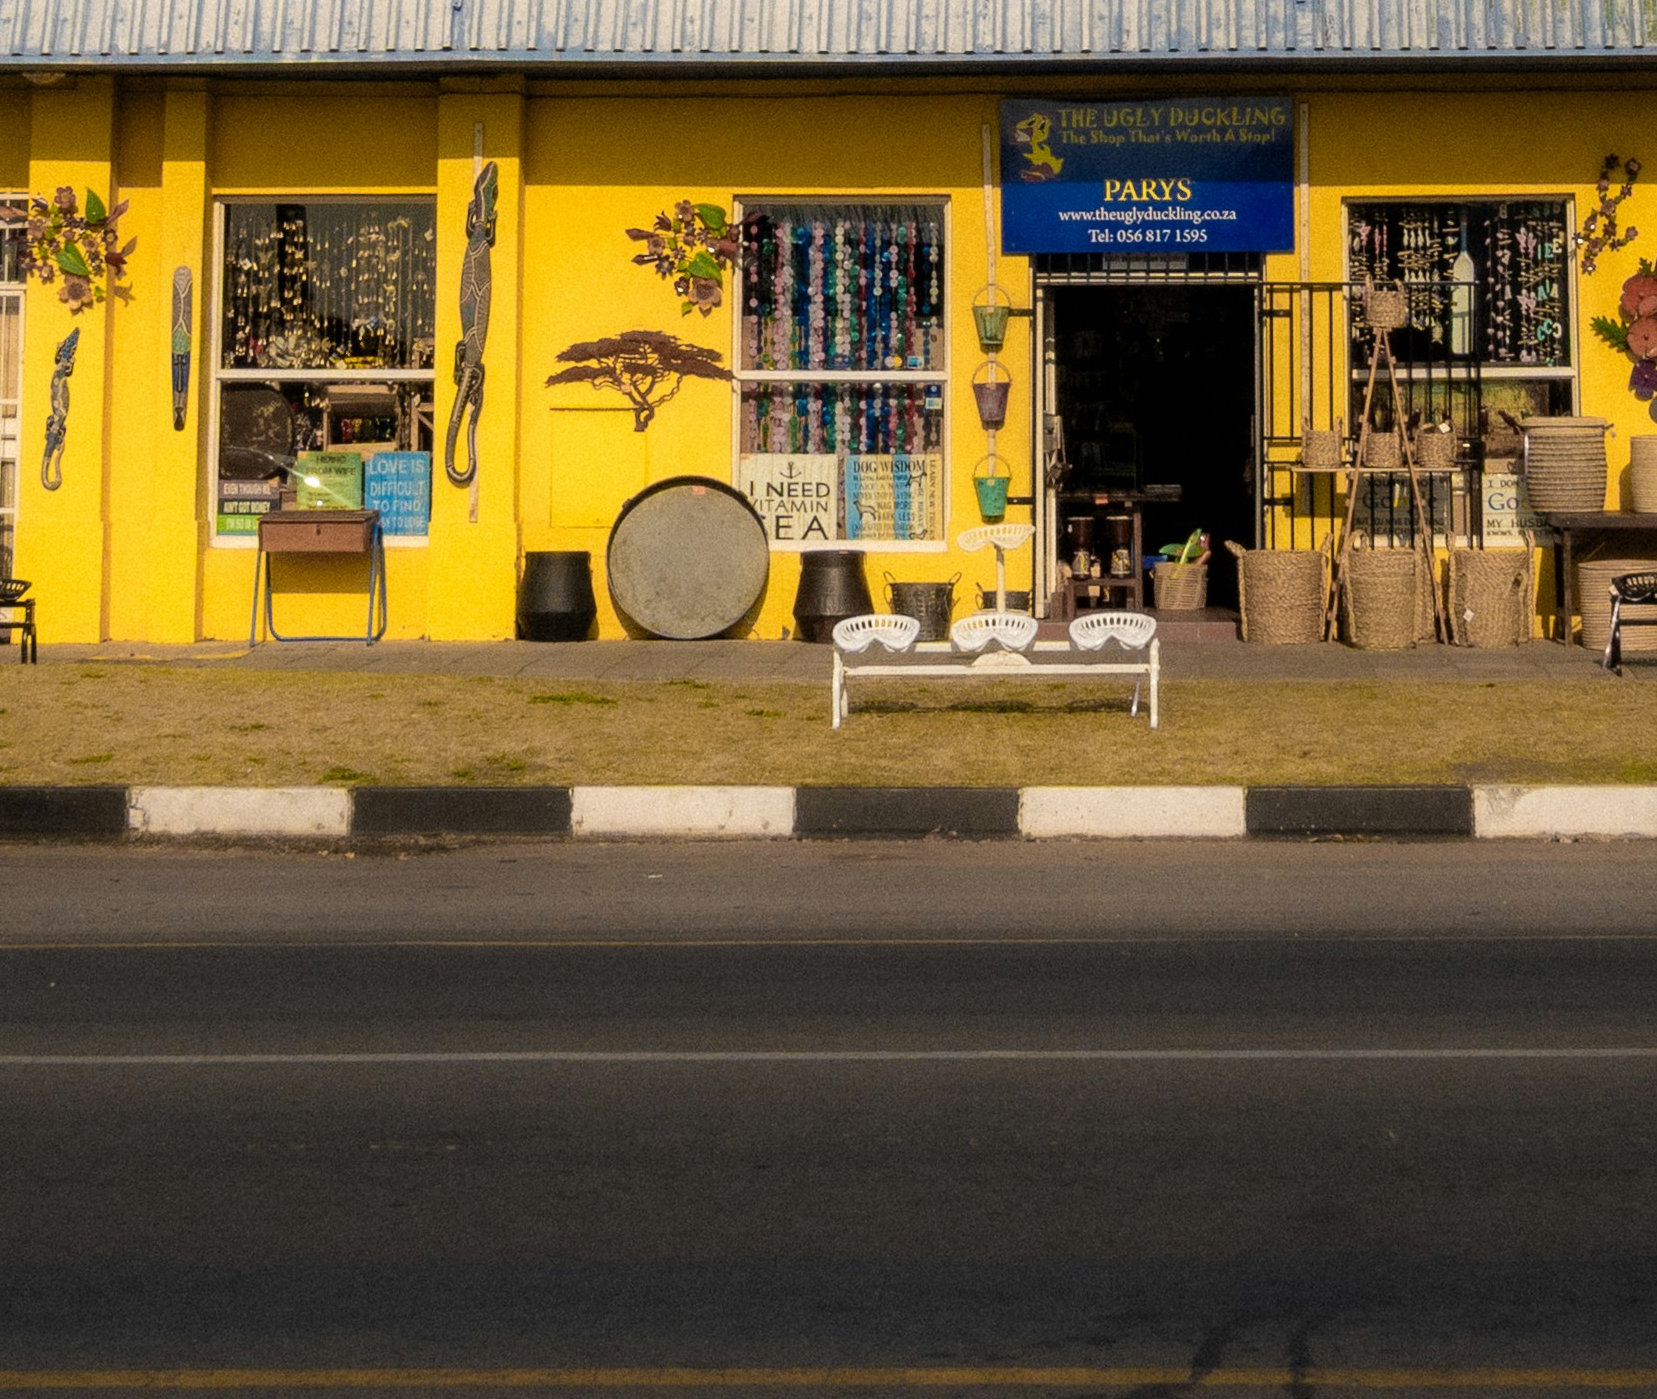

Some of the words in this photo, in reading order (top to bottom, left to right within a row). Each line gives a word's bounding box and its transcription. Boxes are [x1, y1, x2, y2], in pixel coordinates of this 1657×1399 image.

[1058, 108, 1097, 128] THE
[1103, 107, 1163, 128] UGLY
[1169, 106, 1286, 127] DUCKLING
[1060, 130, 1087, 144] The
[1090, 129, 1125, 147] Shop
[1129, 129, 1172, 144] That's
[1175, 128, 1221, 143] Worth
[1224, 129, 1236, 143] A
[1103, 177, 1192, 202] PARYS
[1058, 205, 1237, 225] www.theuglyduckling.co.za
[1088, 228, 1114, 243] Tel:
[1116, 229, 1142, 243] 056
[1145, 229, 1171, 243] 817
[1175, 229, 1208, 243] 1595
[368, 458, 408, 474] LOVE
[411, 459, 425, 474] IS
[853, 460, 877, 474] DOG
[879, 459, 925, 474] WISDOM
[749, 480, 754, 496] I
[765, 481, 830, 498] NEED
[1487, 480, 1494, 488] I
[1500, 478, 1524, 488] DON'
[372, 500, 390, 512] TO
[760, 514, 829, 540] EA
[1487, 518, 1503, 528] MY
